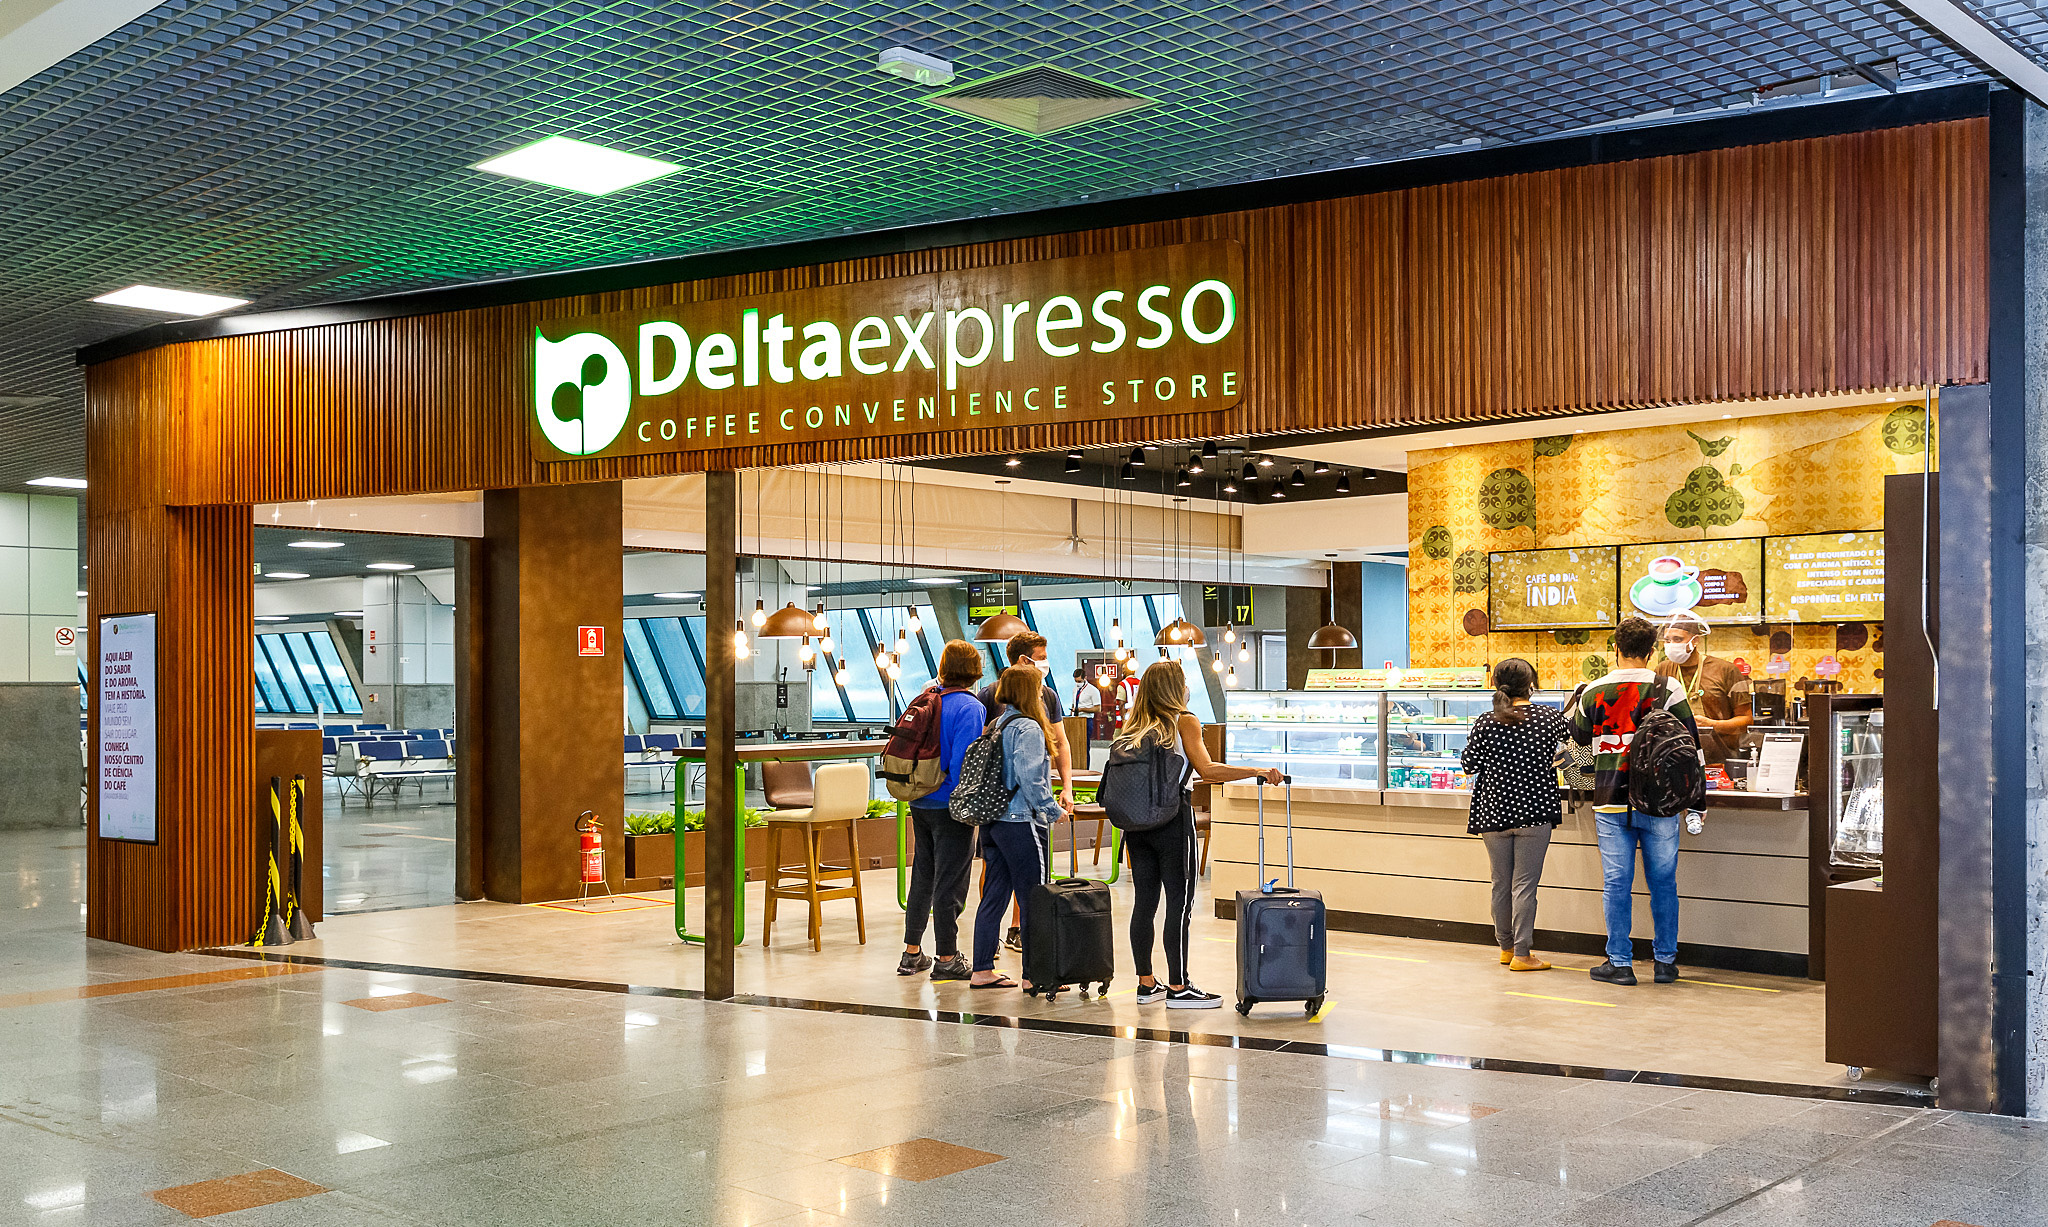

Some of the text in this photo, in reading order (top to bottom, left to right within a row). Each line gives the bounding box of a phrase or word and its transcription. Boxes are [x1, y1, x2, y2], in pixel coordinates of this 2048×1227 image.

[638, 279, 1236, 396] Deltaexpresso
[637, 371, 1237, 442] COFFEE CONVENIENCE STORE
[1816, 550, 1867, 559] REQUINTADO
[1811, 561, 1841, 569] AROMA
[1842, 559, 1873, 567] MÍTICO.
[1526, 572, 1578, 583] CAFÉ DO DIA:
[1797, 580, 1846, 588] ESPECIARIAS
[1526, 584, 1578, 607] ÍNDIA
[1790, 593, 1842, 604] DISPONÍVEL
[1845, 594, 1858, 602] EM
[1236, 605, 1250, 622] 17
[105, 649, 133, 663] AQUI ALÉM
[105, 664, 131, 675] DO SABOR
[109, 678, 117, 687] DO
[118, 677, 138, 687] AROMA,
[105, 691, 116, 701] TEM
[105, 742, 129, 754] CONHEÇA
[105, 755, 144, 765] NOSSO CENTRO
[105, 768, 111, 777] DE
[105, 781, 112, 790] DO
